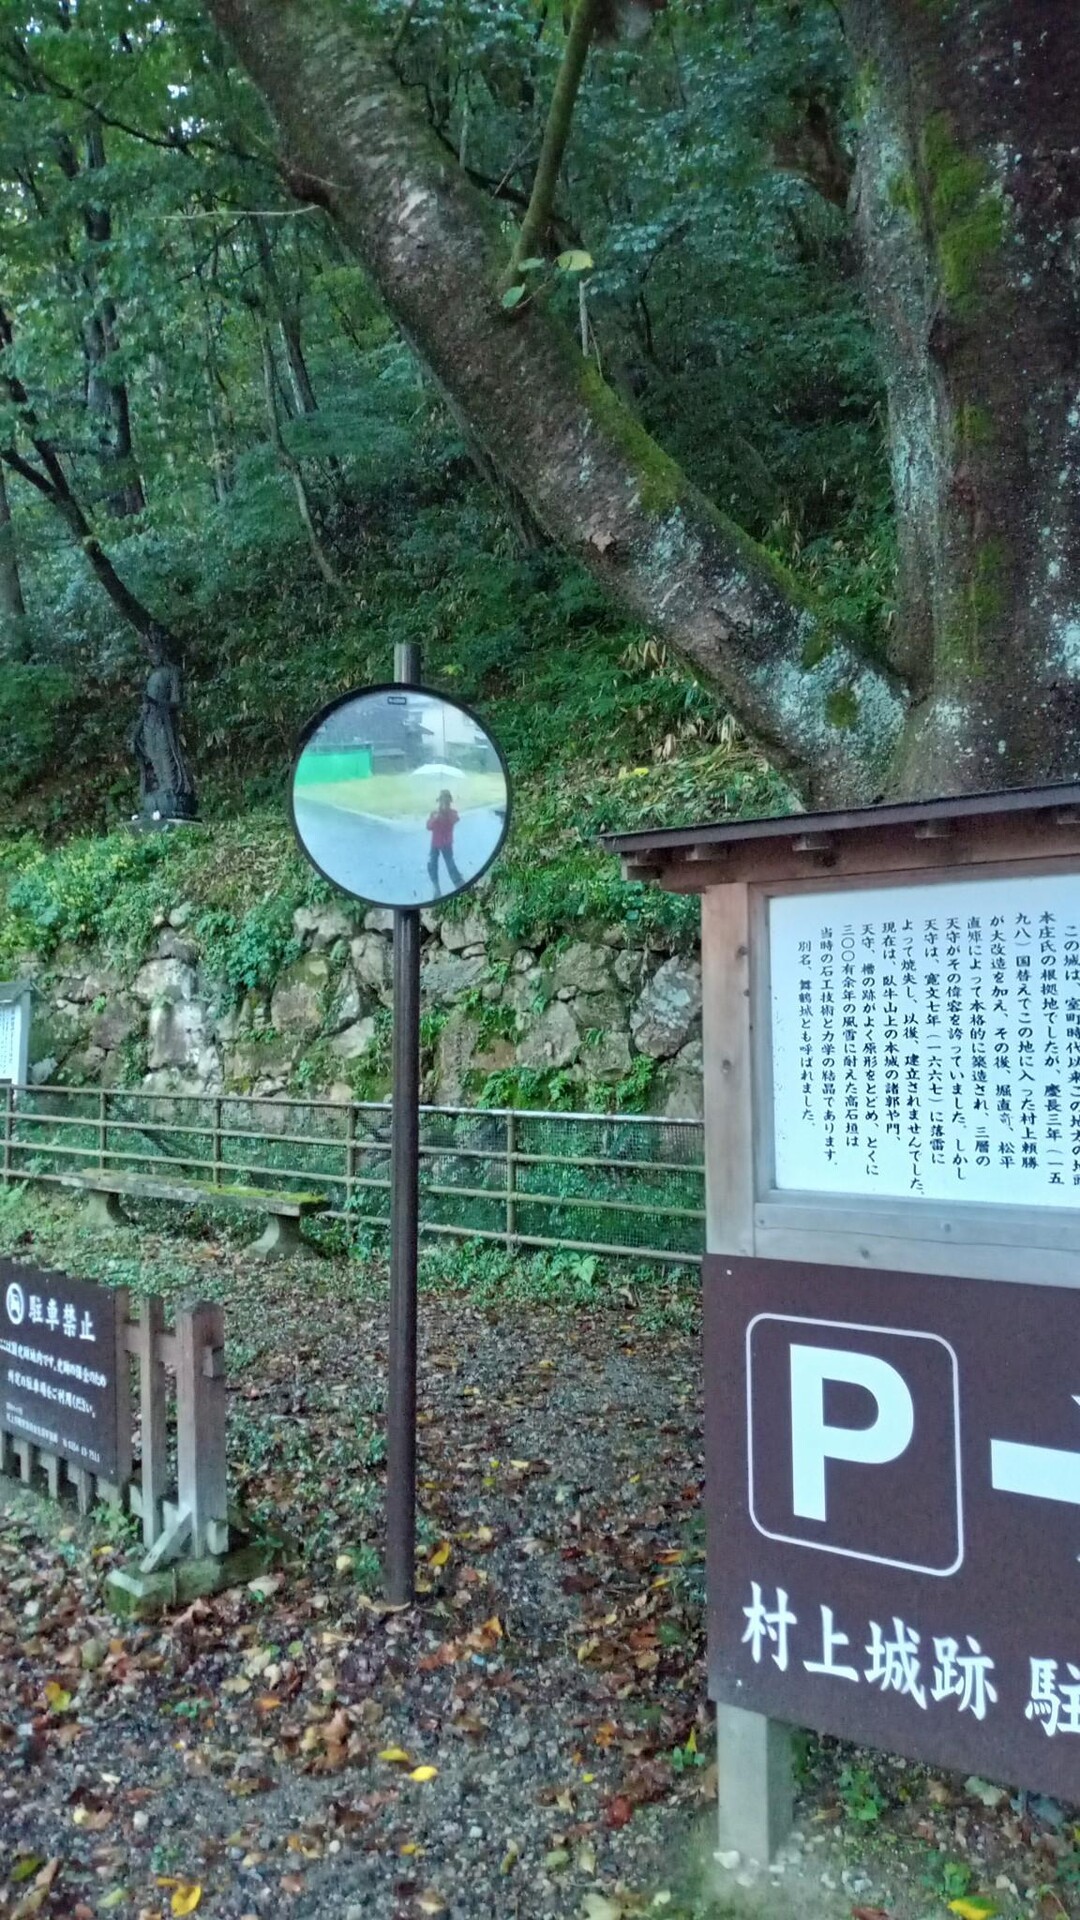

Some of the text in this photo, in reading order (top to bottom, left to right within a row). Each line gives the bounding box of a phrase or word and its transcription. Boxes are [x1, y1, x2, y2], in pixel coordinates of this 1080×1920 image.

[28, 1295, 96, 1342] 駐車禁止
[790, 1344, 914, 1522] P
[741, 1580, 998, 1721] 村上城跡
